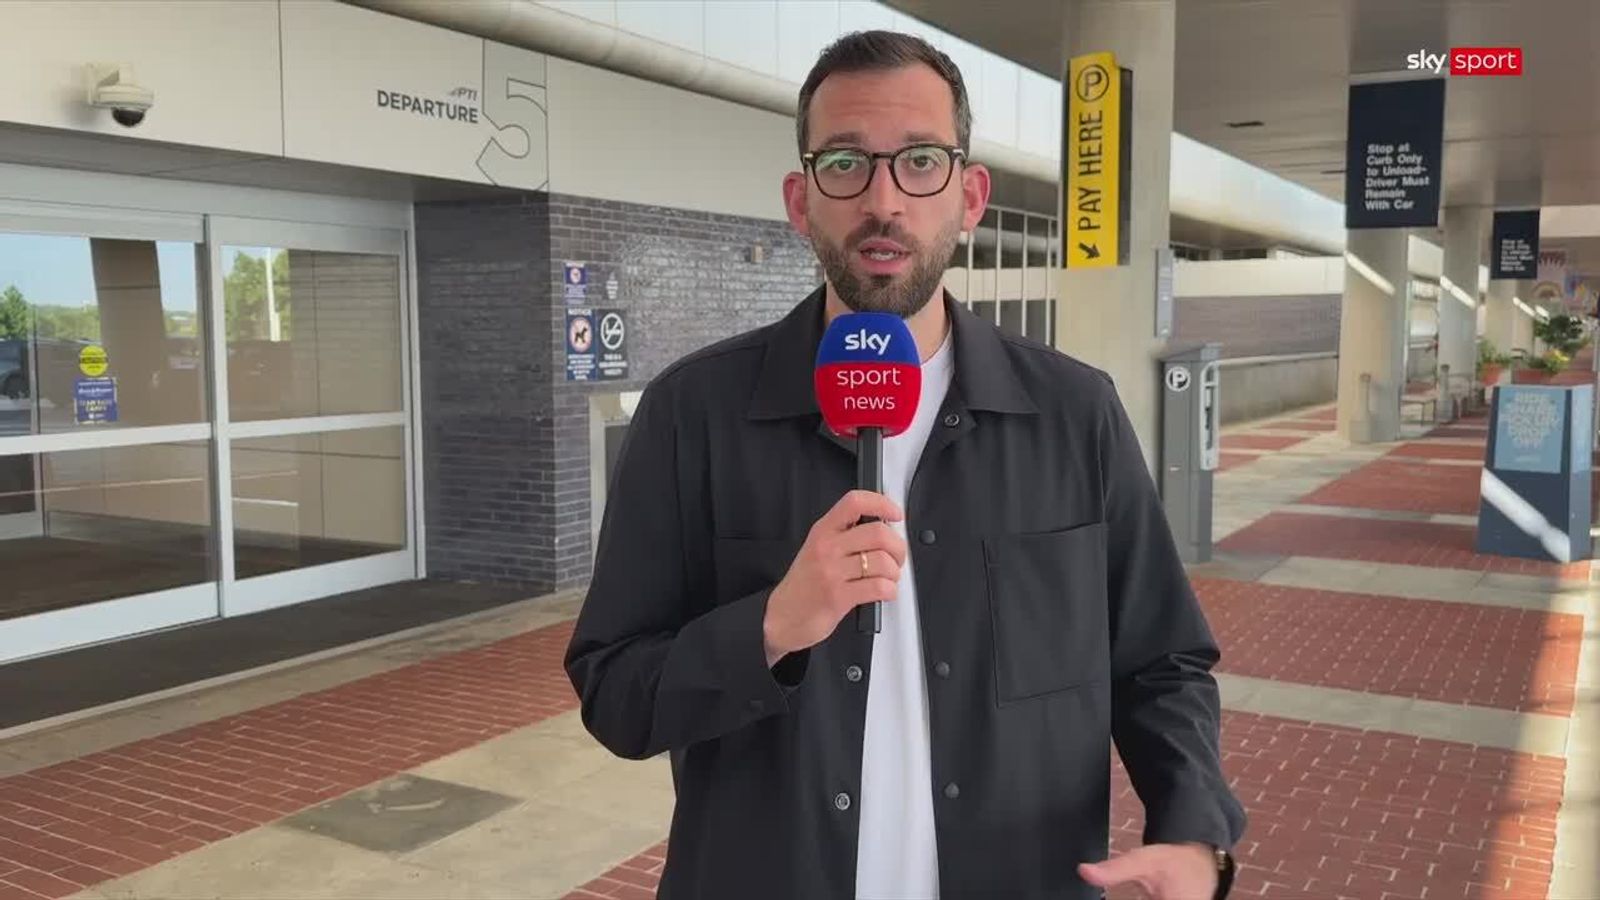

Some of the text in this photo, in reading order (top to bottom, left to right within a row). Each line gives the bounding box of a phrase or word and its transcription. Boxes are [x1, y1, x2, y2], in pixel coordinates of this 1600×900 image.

[377, 90, 479, 124] DEPARTURE
[1367, 142, 1410, 155] Stop at
[1366, 153, 1423, 165] Curb Only
[1078, 110, 1103, 231] PAY HERE
[1366, 167, 1379, 176] to
[1365, 176, 1430, 188] Driver Must
[1365, 189, 1406, 199] Remain
[1365, 199, 1415, 210] With Car
[845, 328, 891, 355] sky
[837, 368, 901, 389] sport
[844, 396, 895, 410] news
